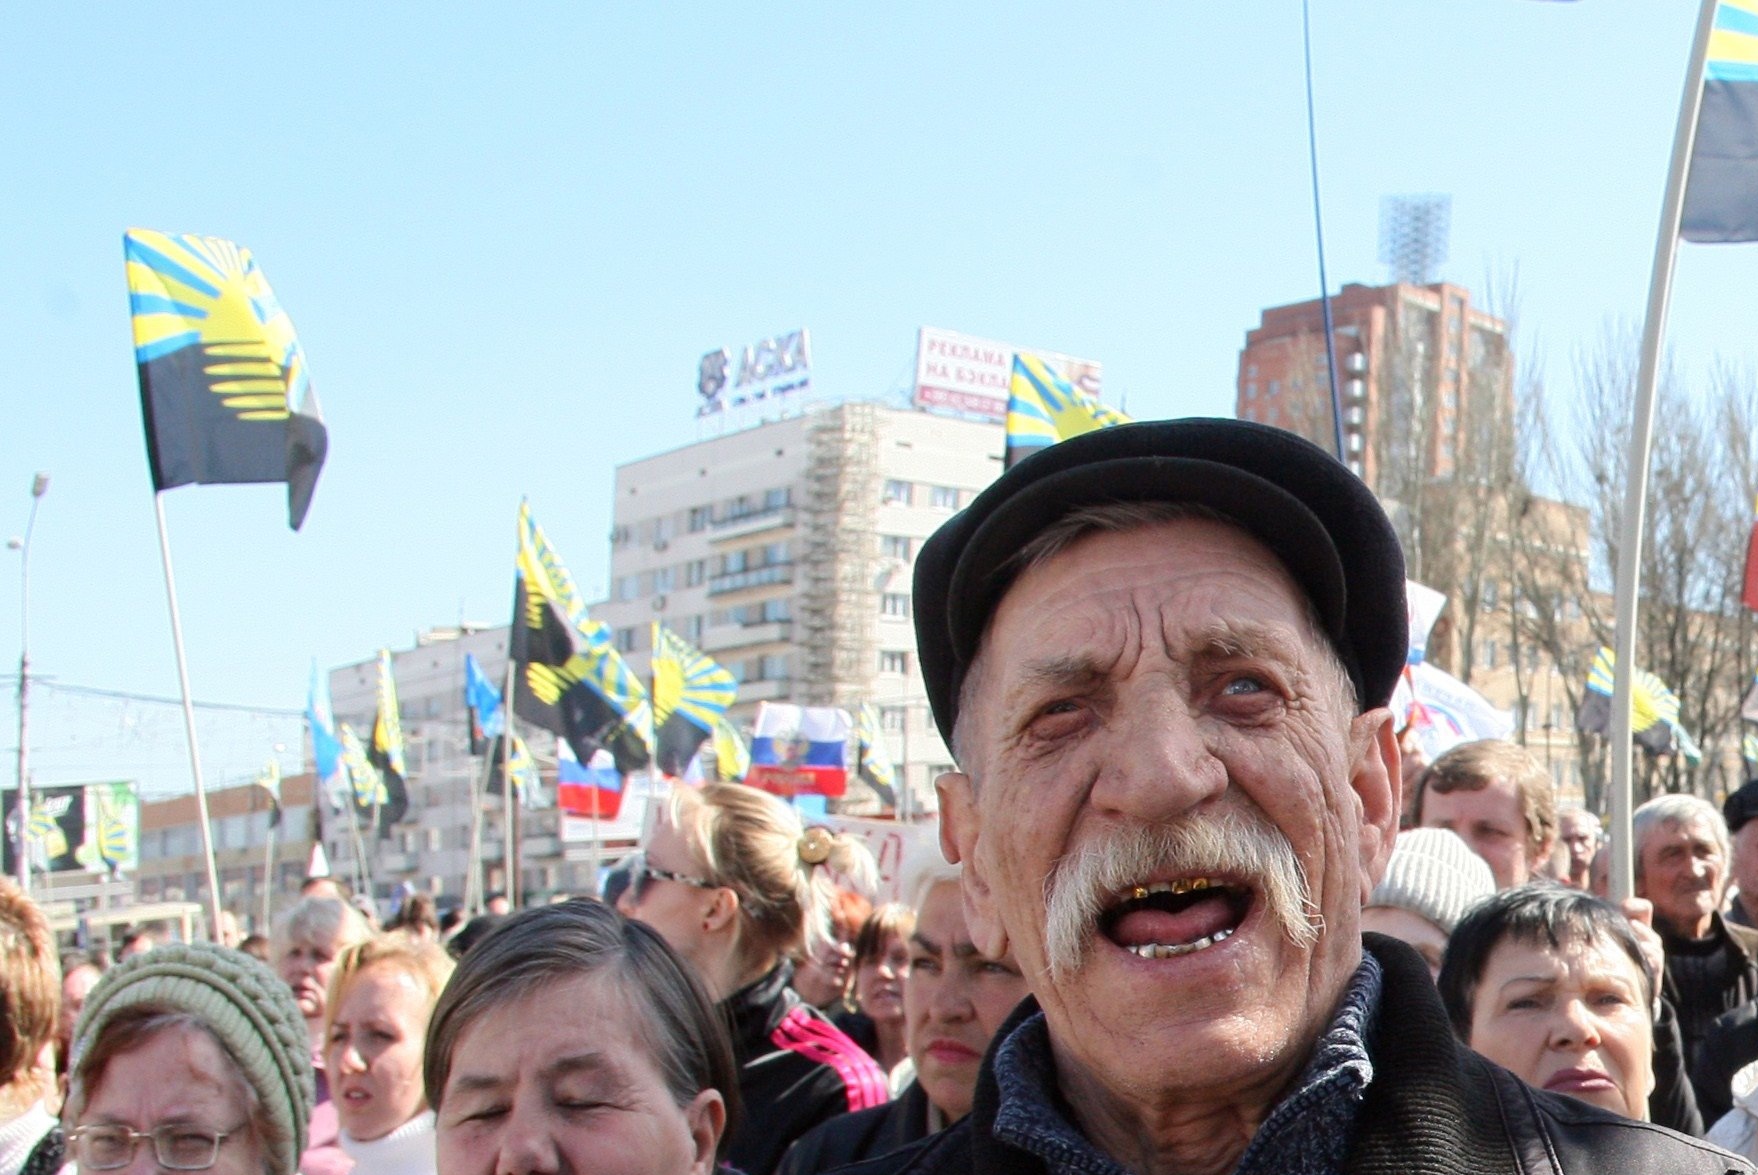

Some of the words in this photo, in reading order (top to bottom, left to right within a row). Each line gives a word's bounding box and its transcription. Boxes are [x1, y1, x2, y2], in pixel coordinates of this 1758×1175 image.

[734, 328, 811, 388] АСКА
[926, 338, 1007, 367] РЕКЛАМА
[926, 361, 949, 379] НА
